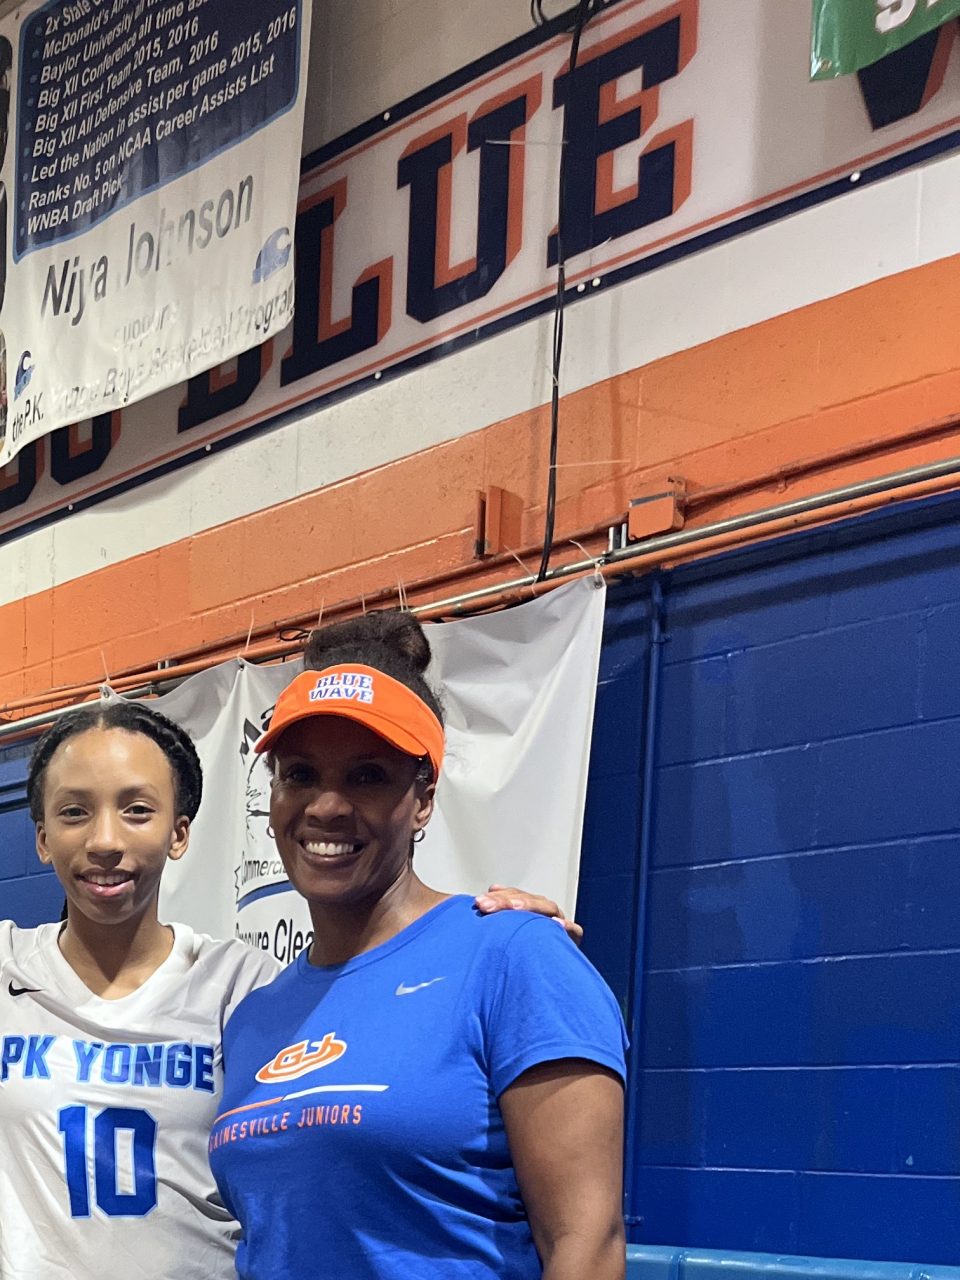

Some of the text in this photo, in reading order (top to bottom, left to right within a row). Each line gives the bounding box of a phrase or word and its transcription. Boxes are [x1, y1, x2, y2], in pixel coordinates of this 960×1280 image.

[37, 87, 60, 108] Big
[63, 73, 79, 99] XII
[82, 32, 137, 87] Conference
[138, 14, 152, 39] all
[156, 2, 184, 29] time
[40, 52, 82, 84] Baylor
[83, 11, 133, 62] University
[42, 9, 109, 60] McDonald's
[45, 1, 91, 36] 2x State
[31, 6, 296, 183] Led the Nation in assist per game 2015, 2016
[33, 30, 219, 158] Big XII All Defensive Team, 2016
[35, 16, 199, 132] Big XII First Team 2015, 2016
[29, 53, 275, 211] Ranks No. 5 on NCAA Career Assists List
[28, 171, 123, 235] WNBA Draft Pick
[122, 174, 254, 287] Johnson
[310, 687, 372, 702] WAVE
[317, 673, 372, 689] BLUE
[0, 1034, 215, 1095] PK YONGE
[297, 1104, 363, 1128] JUNIORS
[57, 1104, 158, 1219] 10
